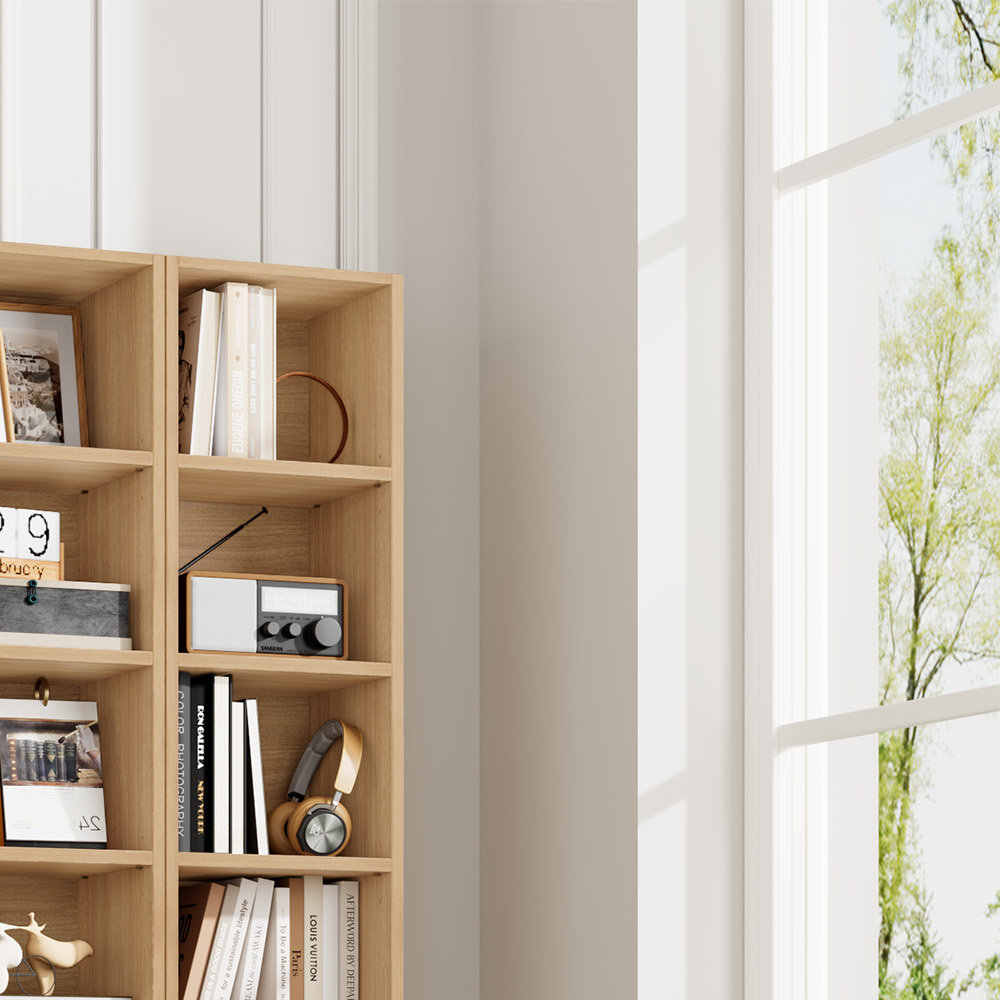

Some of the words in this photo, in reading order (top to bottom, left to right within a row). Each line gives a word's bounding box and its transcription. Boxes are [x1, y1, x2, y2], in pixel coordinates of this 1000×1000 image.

[232, 371, 244, 409] ONEGIN
[232, 412, 244, 453] EUGENE
[280, 925, 287, 934] To
[347, 893, 355, 952] AFTERWORD
[220, 979, 228, 990] for
[225, 928, 241, 971] sustainable
[235, 898, 249, 928] lifestyle
[280, 936, 287, 946] Be
[292, 950, 302, 977] Paris
[347, 954, 355, 967] BY
